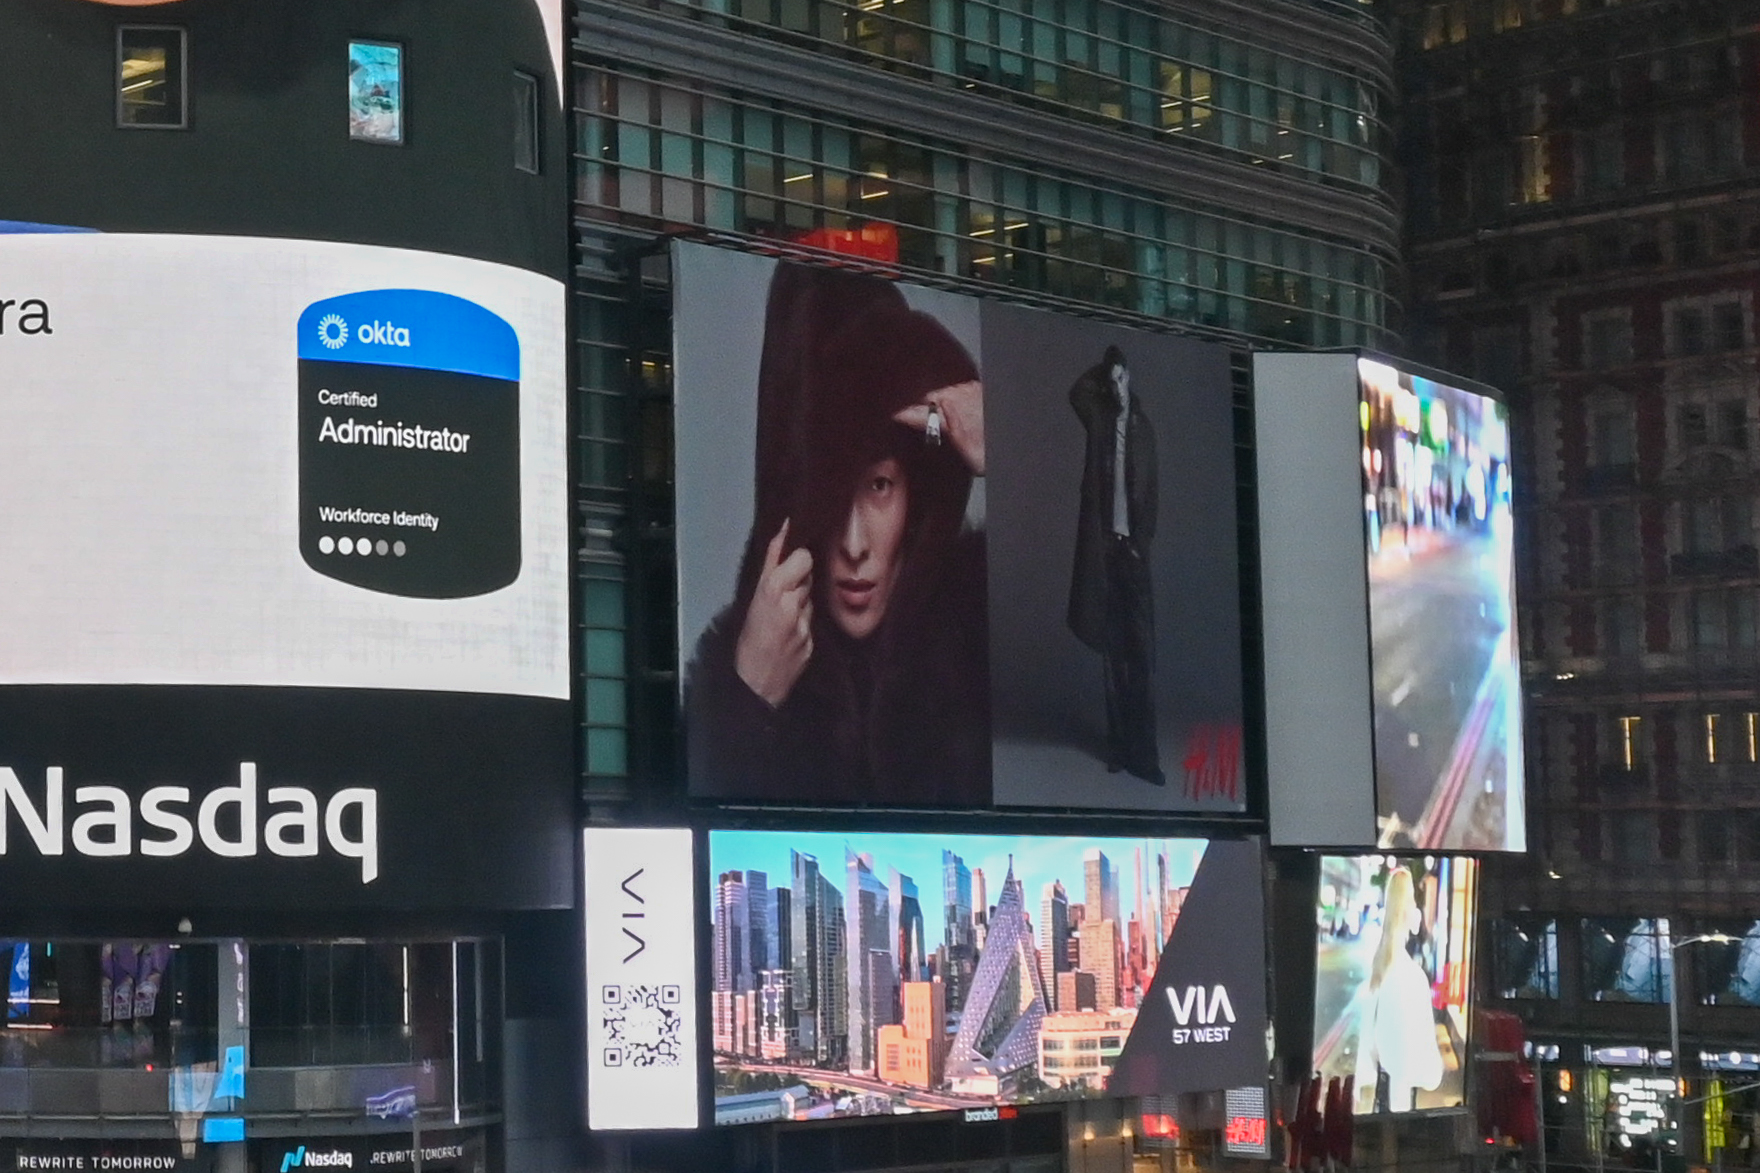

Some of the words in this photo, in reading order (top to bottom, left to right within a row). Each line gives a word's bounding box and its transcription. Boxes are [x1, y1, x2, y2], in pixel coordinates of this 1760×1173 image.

[357, 319, 411, 347] okta
[318, 389, 378, 408] Certified
[318, 416, 471, 453] Administrator
[318, 506, 391, 525] Workforce
[392, 510, 439, 532] Identity
[1165, 984, 1237, 1025] VIA
[1172, 1028, 1192, 1045] 57
[1192, 1026, 1232, 1044] WEST
[19, 1156, 84, 1169] REWRITE
[91, 1156, 176, 1169] TOMORROW
[305, 1149, 353, 1169] Nasdaq
